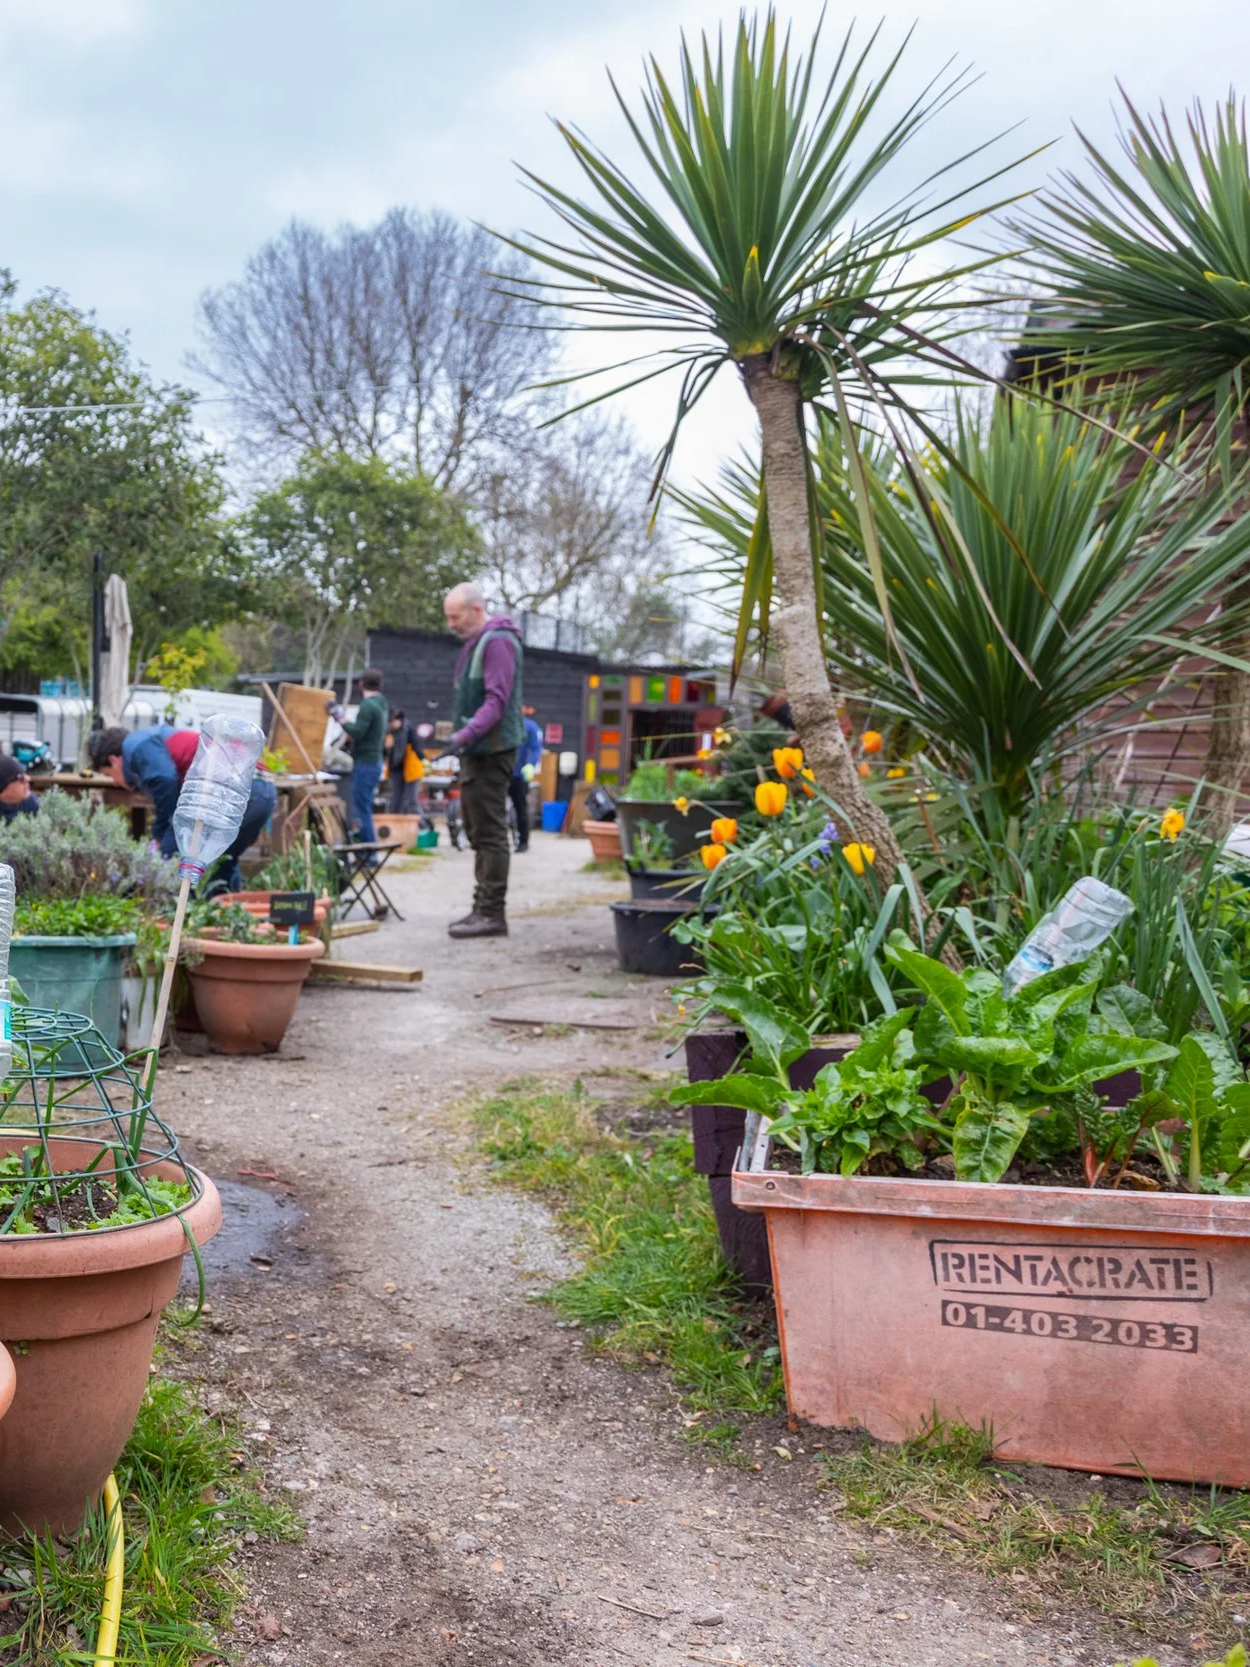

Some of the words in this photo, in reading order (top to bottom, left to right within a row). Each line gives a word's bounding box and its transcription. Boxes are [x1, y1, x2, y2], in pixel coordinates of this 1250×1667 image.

[940, 1251, 1198, 1291] RENTACRATE
[944, 1302, 1079, 1339] 01-403
[1090, 1318, 1194, 1351] 2033
